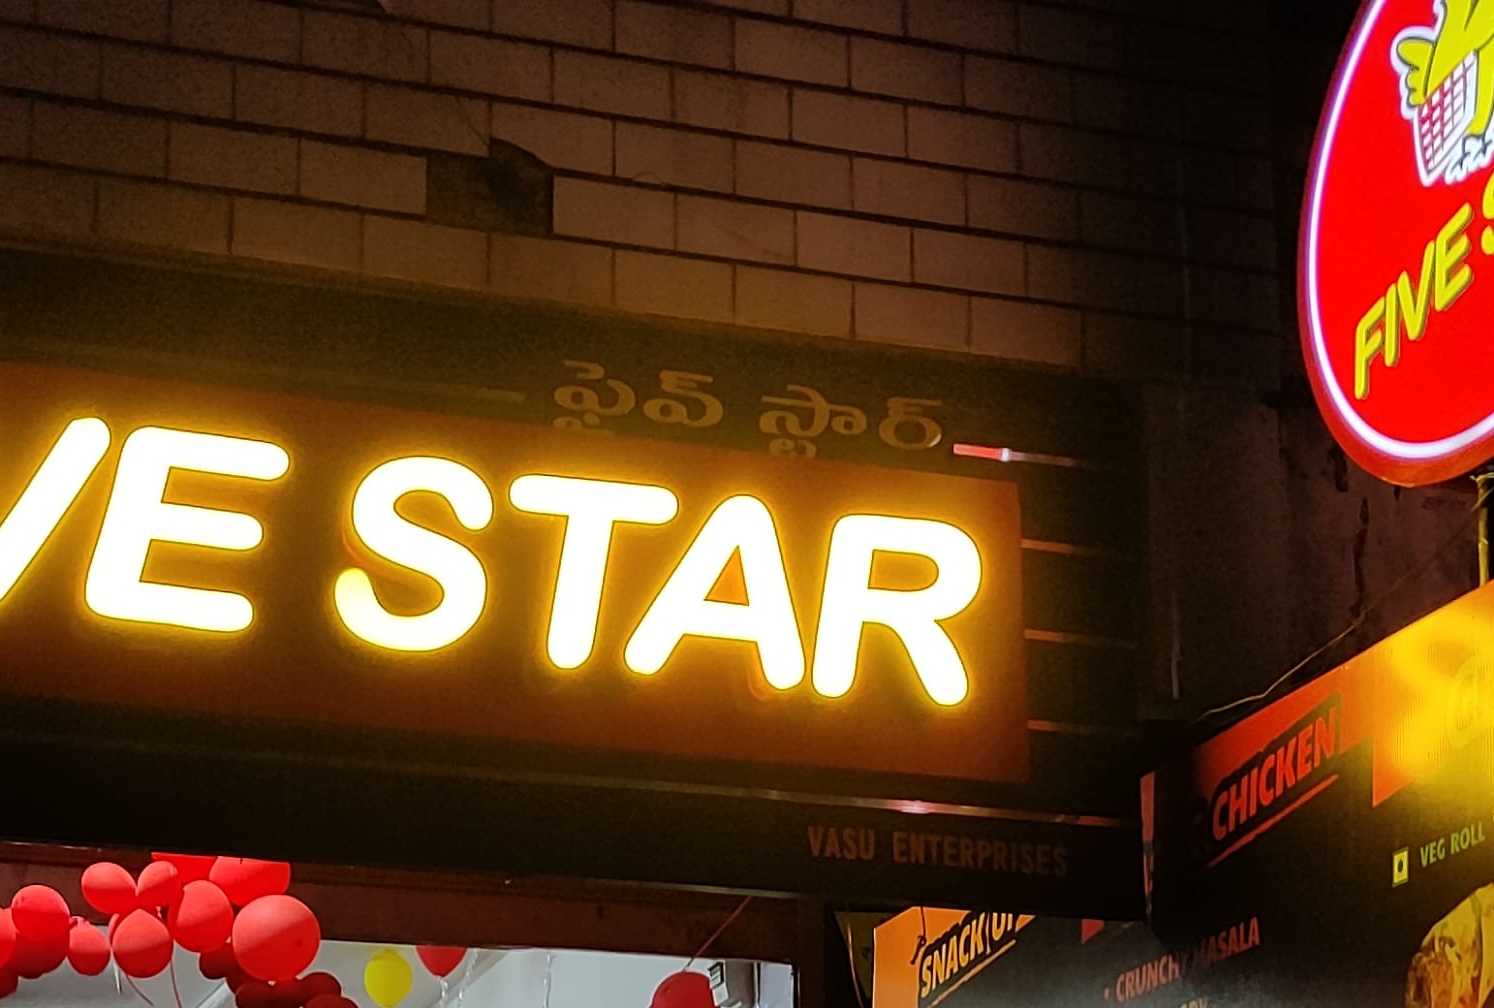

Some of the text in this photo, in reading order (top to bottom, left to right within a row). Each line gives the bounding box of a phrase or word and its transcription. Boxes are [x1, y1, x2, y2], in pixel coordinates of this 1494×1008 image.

[1354, 203, 1473, 400] FIVE
[334, 455, 987, 707] STAR
[1212, 707, 1338, 841] CHICKEN
[807, 825, 1068, 878] VASU ENTERPRISES
[1420, 821, 1485, 868] VEG ROLL
[921, 912, 986, 998] SNACK
